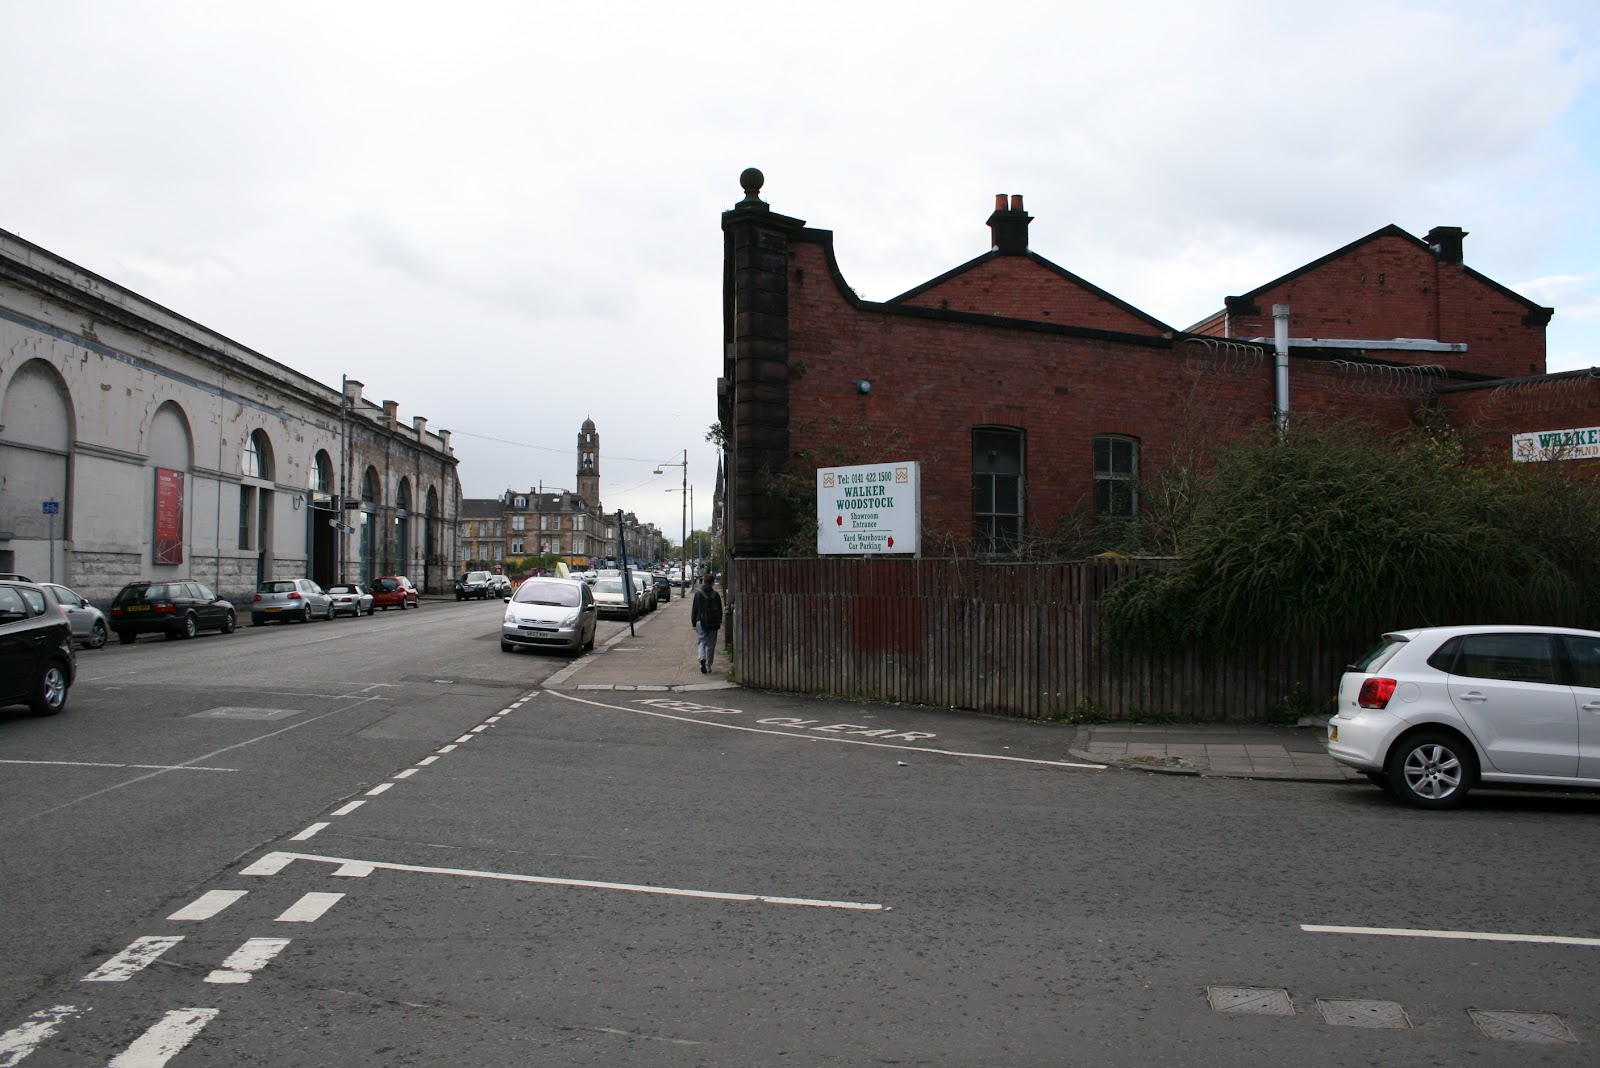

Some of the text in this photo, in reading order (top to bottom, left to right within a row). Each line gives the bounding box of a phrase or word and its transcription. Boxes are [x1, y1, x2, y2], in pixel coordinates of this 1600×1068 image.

[1538, 429, 1600, 449] WALKE
[838, 471, 892, 484] Tel: 0141 422 1500
[844, 485, 885, 497] WALKER
[836, 497, 894, 510] WOODSTOCK
[850, 512, 879, 520] Showroom
[843, 533, 887, 542] Yard Warehouse
[848, 542, 882, 551] Car Parking
[632, 698, 937, 741] KEEP CLEAR
